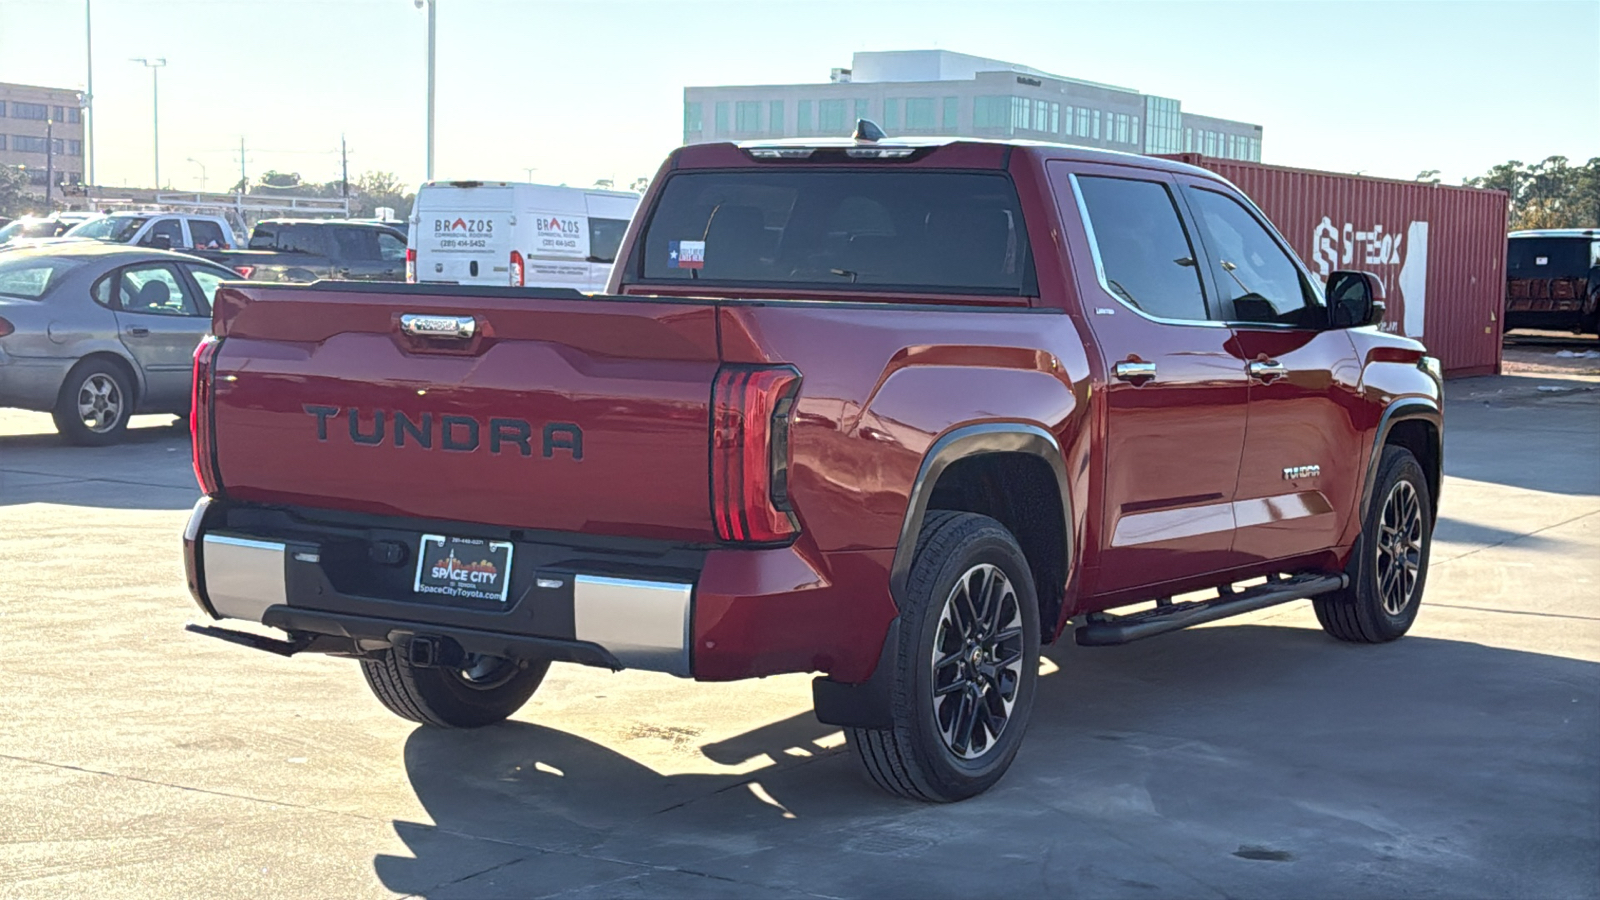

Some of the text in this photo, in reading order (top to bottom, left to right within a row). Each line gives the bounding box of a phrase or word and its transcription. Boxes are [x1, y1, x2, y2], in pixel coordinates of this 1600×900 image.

[434, 217, 493, 232] BRAZOS
[536, 217, 580, 233] BRAZOS
[302, 403, 584, 461] TUNDRA
[1283, 464, 1321, 480] TUNDRA
[432, 567, 497, 584] SPACE CITY
[420, 584, 502, 600] SpaceCityToyota.com
